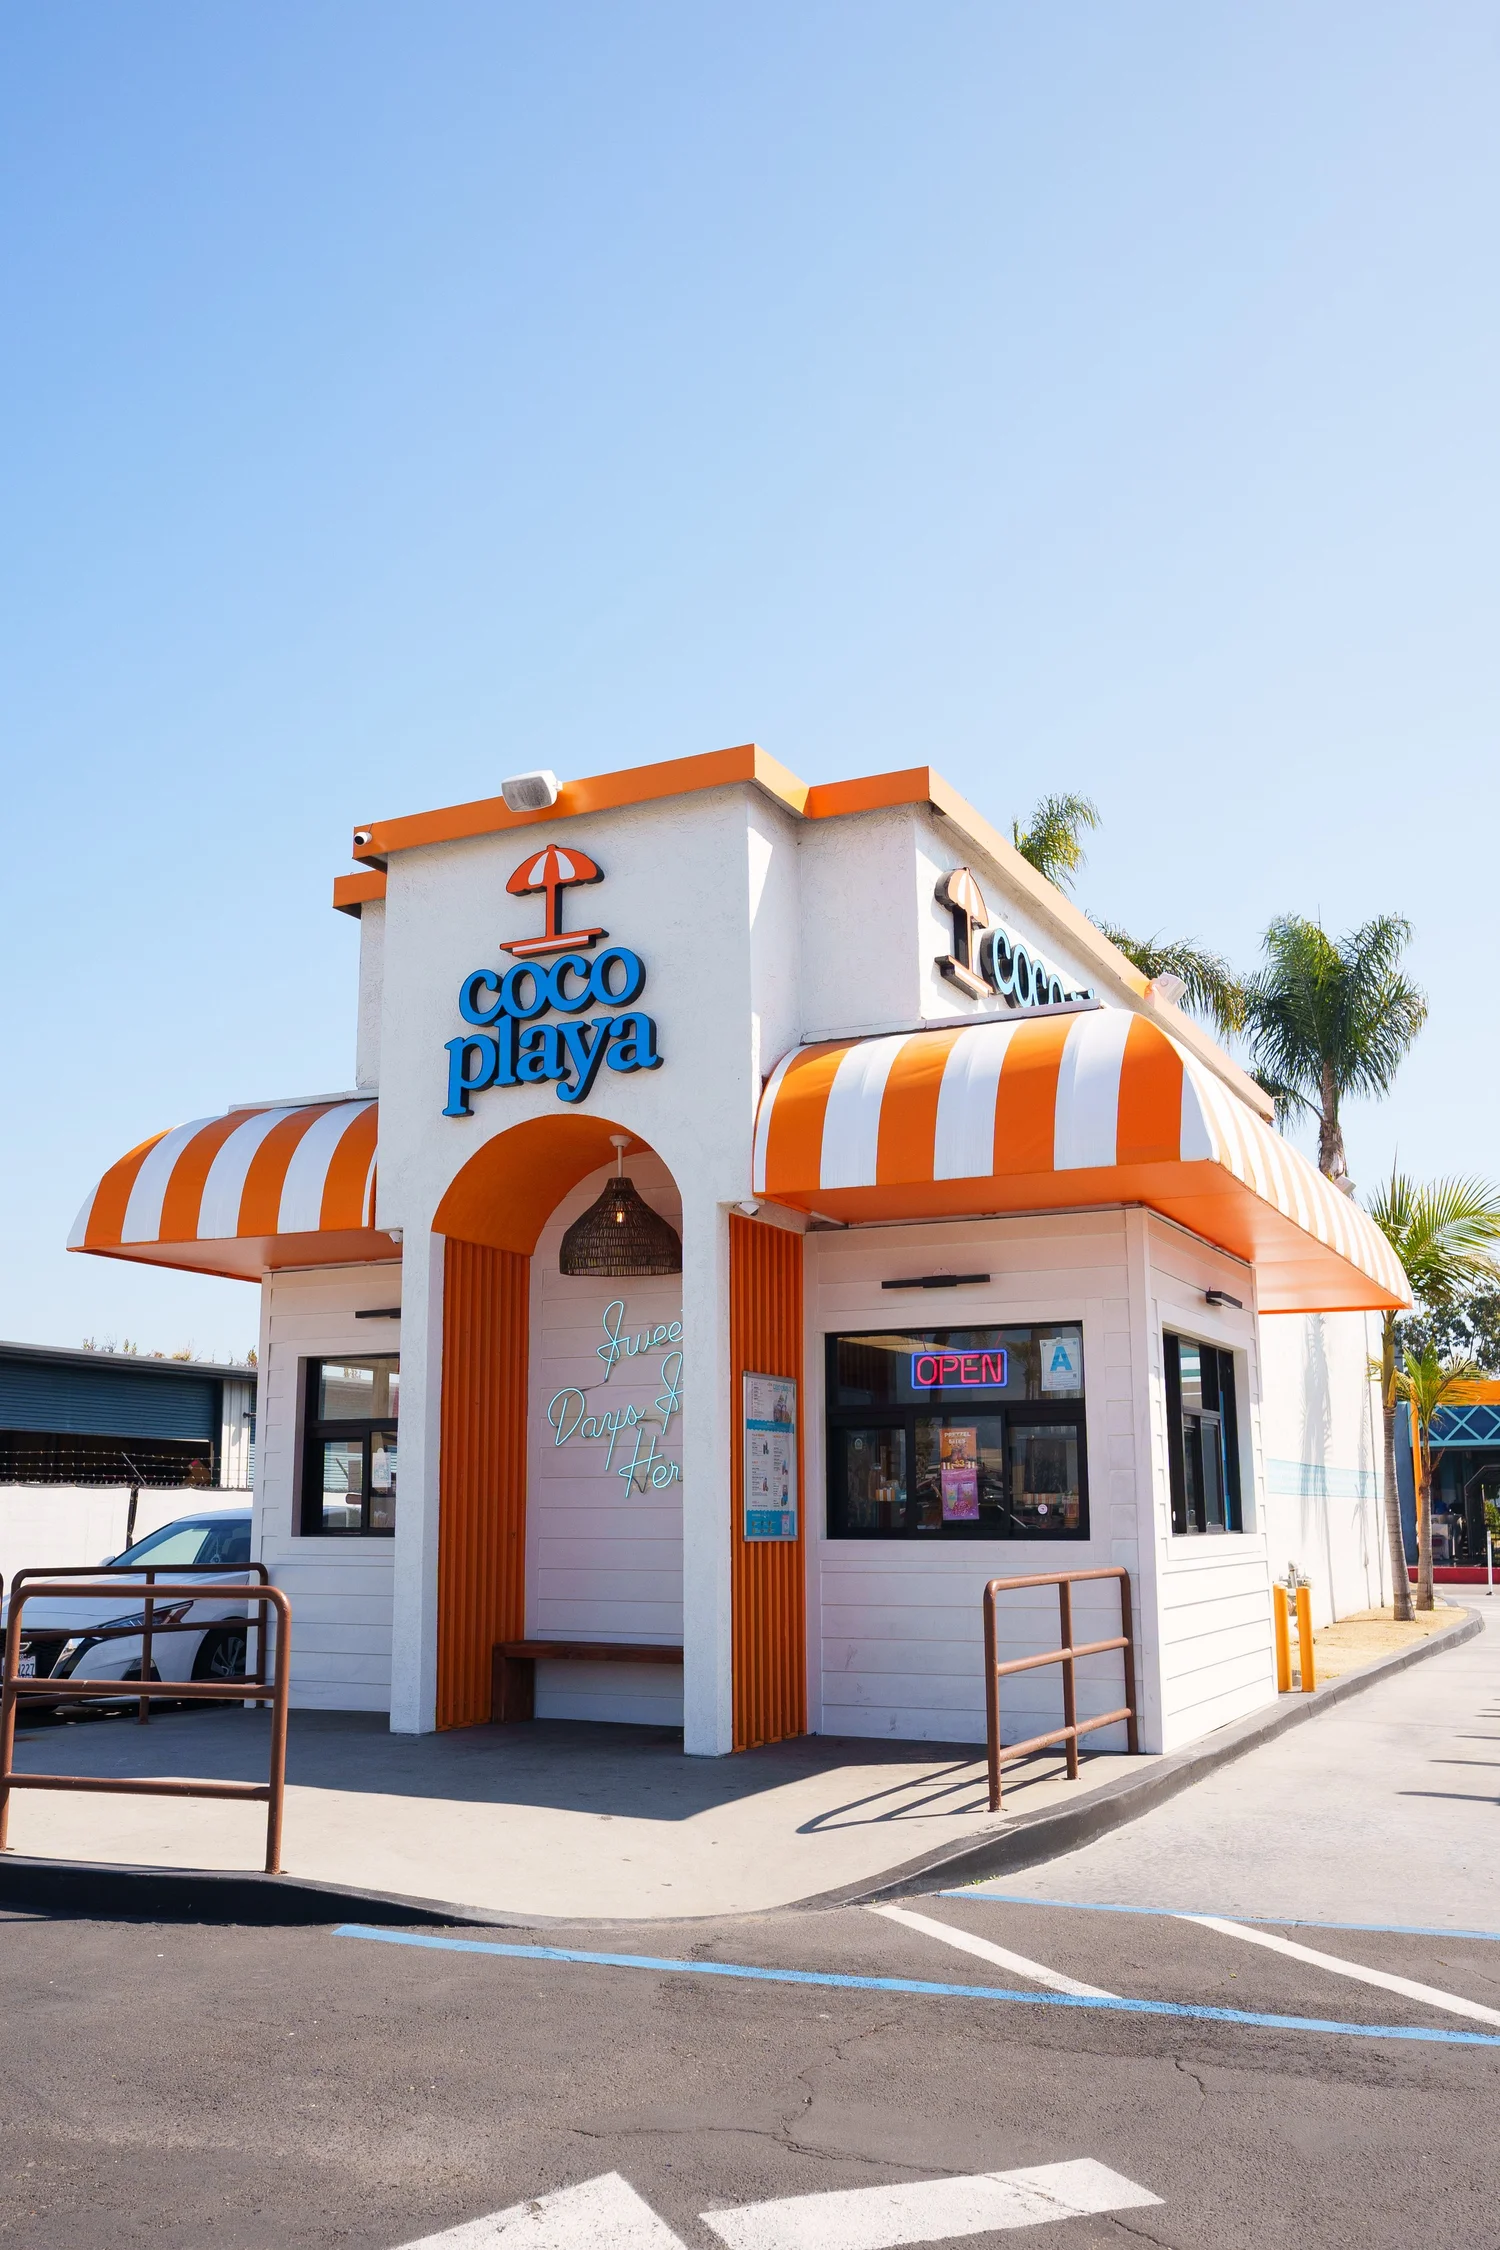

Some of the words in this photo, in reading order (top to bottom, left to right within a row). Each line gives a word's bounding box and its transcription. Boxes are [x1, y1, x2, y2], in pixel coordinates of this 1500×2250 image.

[458, 946, 646, 1027] coco
[442, 1011, 664, 1118] playa
[596, 1300, 684, 1380] Swee
[916, 1353, 1002, 1385] OPEN
[1050, 1345, 1073, 1372] A
[547, 1387, 647, 1471] Days
[617, 1427, 684, 1499] Her
